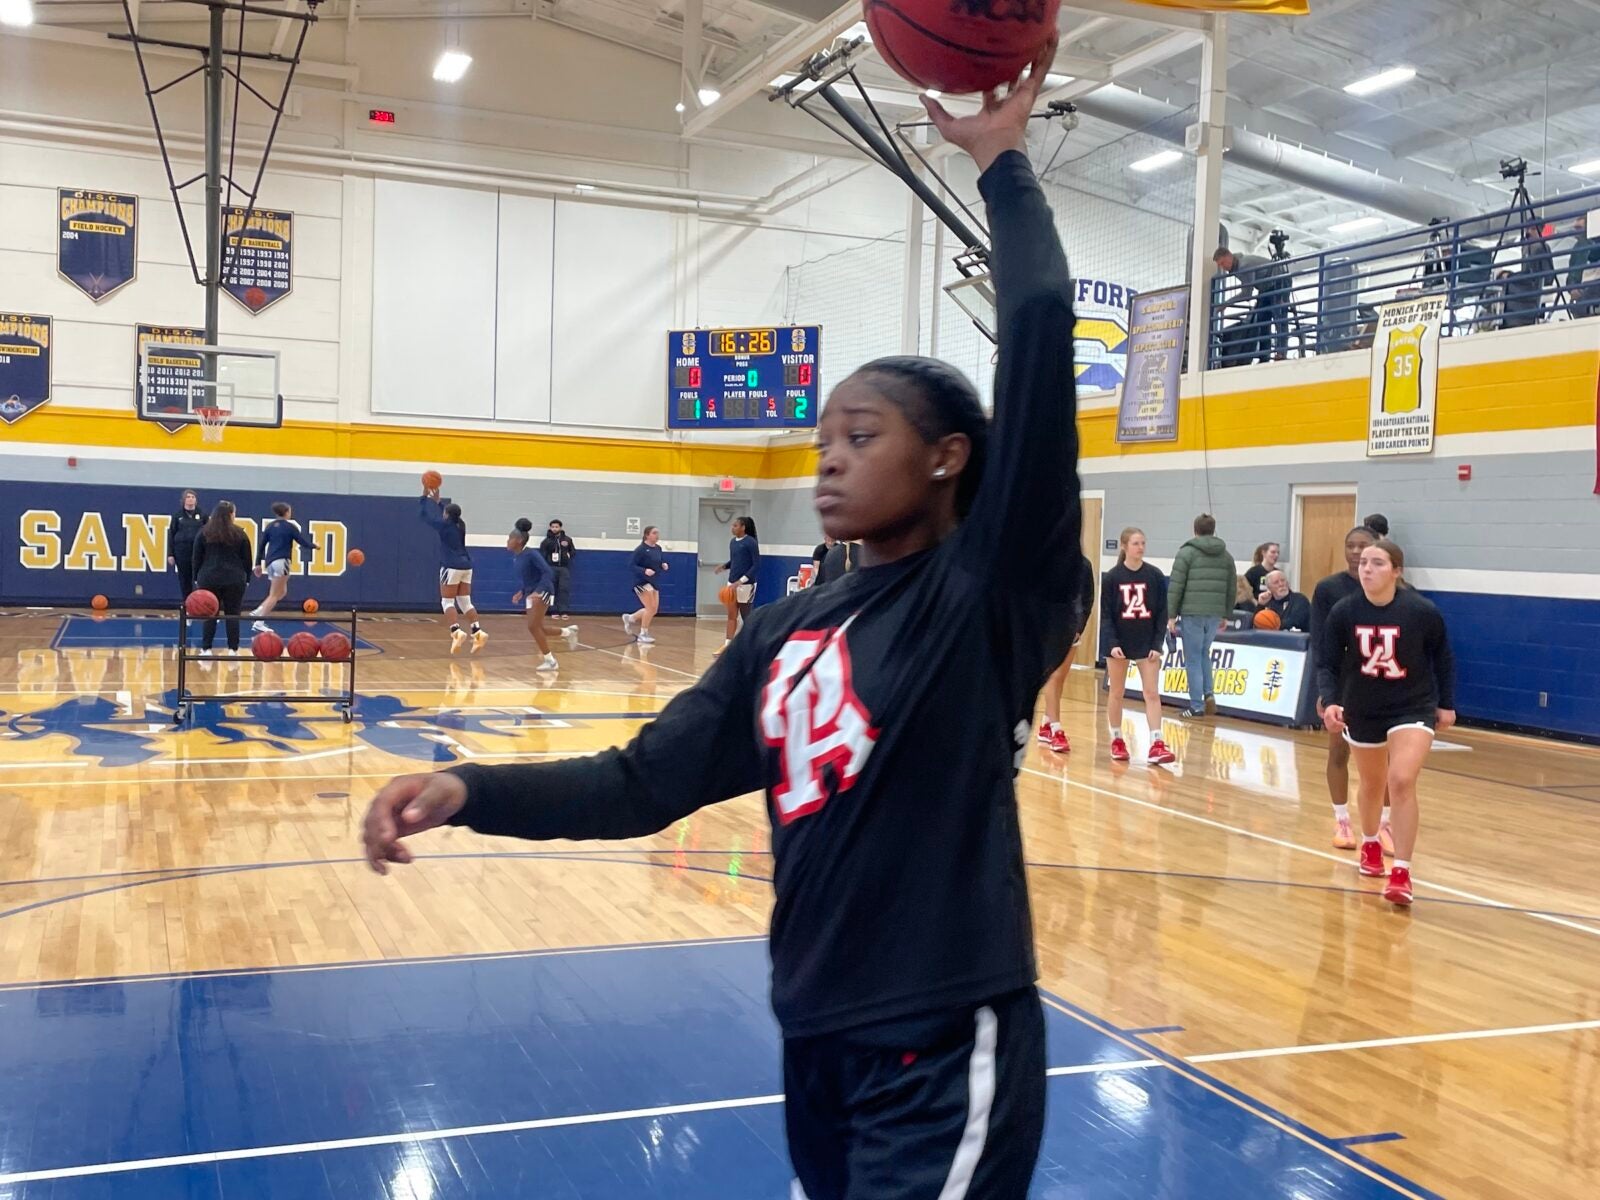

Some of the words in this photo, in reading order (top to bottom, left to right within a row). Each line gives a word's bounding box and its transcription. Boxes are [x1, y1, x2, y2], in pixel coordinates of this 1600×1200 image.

[61, 197, 134, 228] CHAMPIONS
[234, 208, 279, 219] D..S.C.
[73, 222, 94, 230] FIELD
[95, 224, 122, 233] HOCKEY
[62, 231, 79, 240] 2004
[231, 238, 247, 246] GILS
[248, 240, 281, 249] BASKETBALL
[240, 248, 256, 257] 1992
[257, 250, 272, 258] 1993
[273, 251, 289, 260] 1994
[240, 258, 255, 266] 1997
[222, 267, 238, 275] 202
[1383, 304, 1415, 318] MONICK
[1383, 316, 1406, 327] CLASS
[1408, 314, 1418, 323] OF
[0, 321, 48, 348] MPIONS
[721, 332, 771, 353] 16:26
[165, 358, 199, 366] BASKETBALL
[676, 357, 700, 367] HOME
[781, 354, 815, 365] VISITOR
[1393, 354, 1414, 378] 35
[174, 368, 191, 376] 2012
[192, 369, 204, 377] 201
[689, 367, 701, 387] 0
[799, 365, 812, 386] 0
[174, 378, 187, 386] 201
[723, 374, 746, 383] PERIOD
[747, 369, 758, 388] 0
[174, 387, 187, 395] 202
[192, 389, 205, 397] 202
[748, 390, 768, 398] FOULS
[786, 389, 806, 397] FOULS
[694, 399, 700, 419] 1
[766, 409, 778, 418] TOL
[795, 397, 808, 419] 2
[705, 410, 717, 418] TOL
[1406, 414, 1430, 425] NATIONAL
[1372, 428, 1393, 439] PLAYER
[1394, 428, 1401, 437] OF
[1401, 427, 1413, 436] THE
[1413, 426, 1430, 435] YEAR
[1386, 440, 1407, 449] CAREER
[1408, 438, 1430, 448] POINTS
[19, 509, 348, 577] SAND
[1355, 625, 1408, 680] UA
[1163, 667, 1249, 696] WAORS
